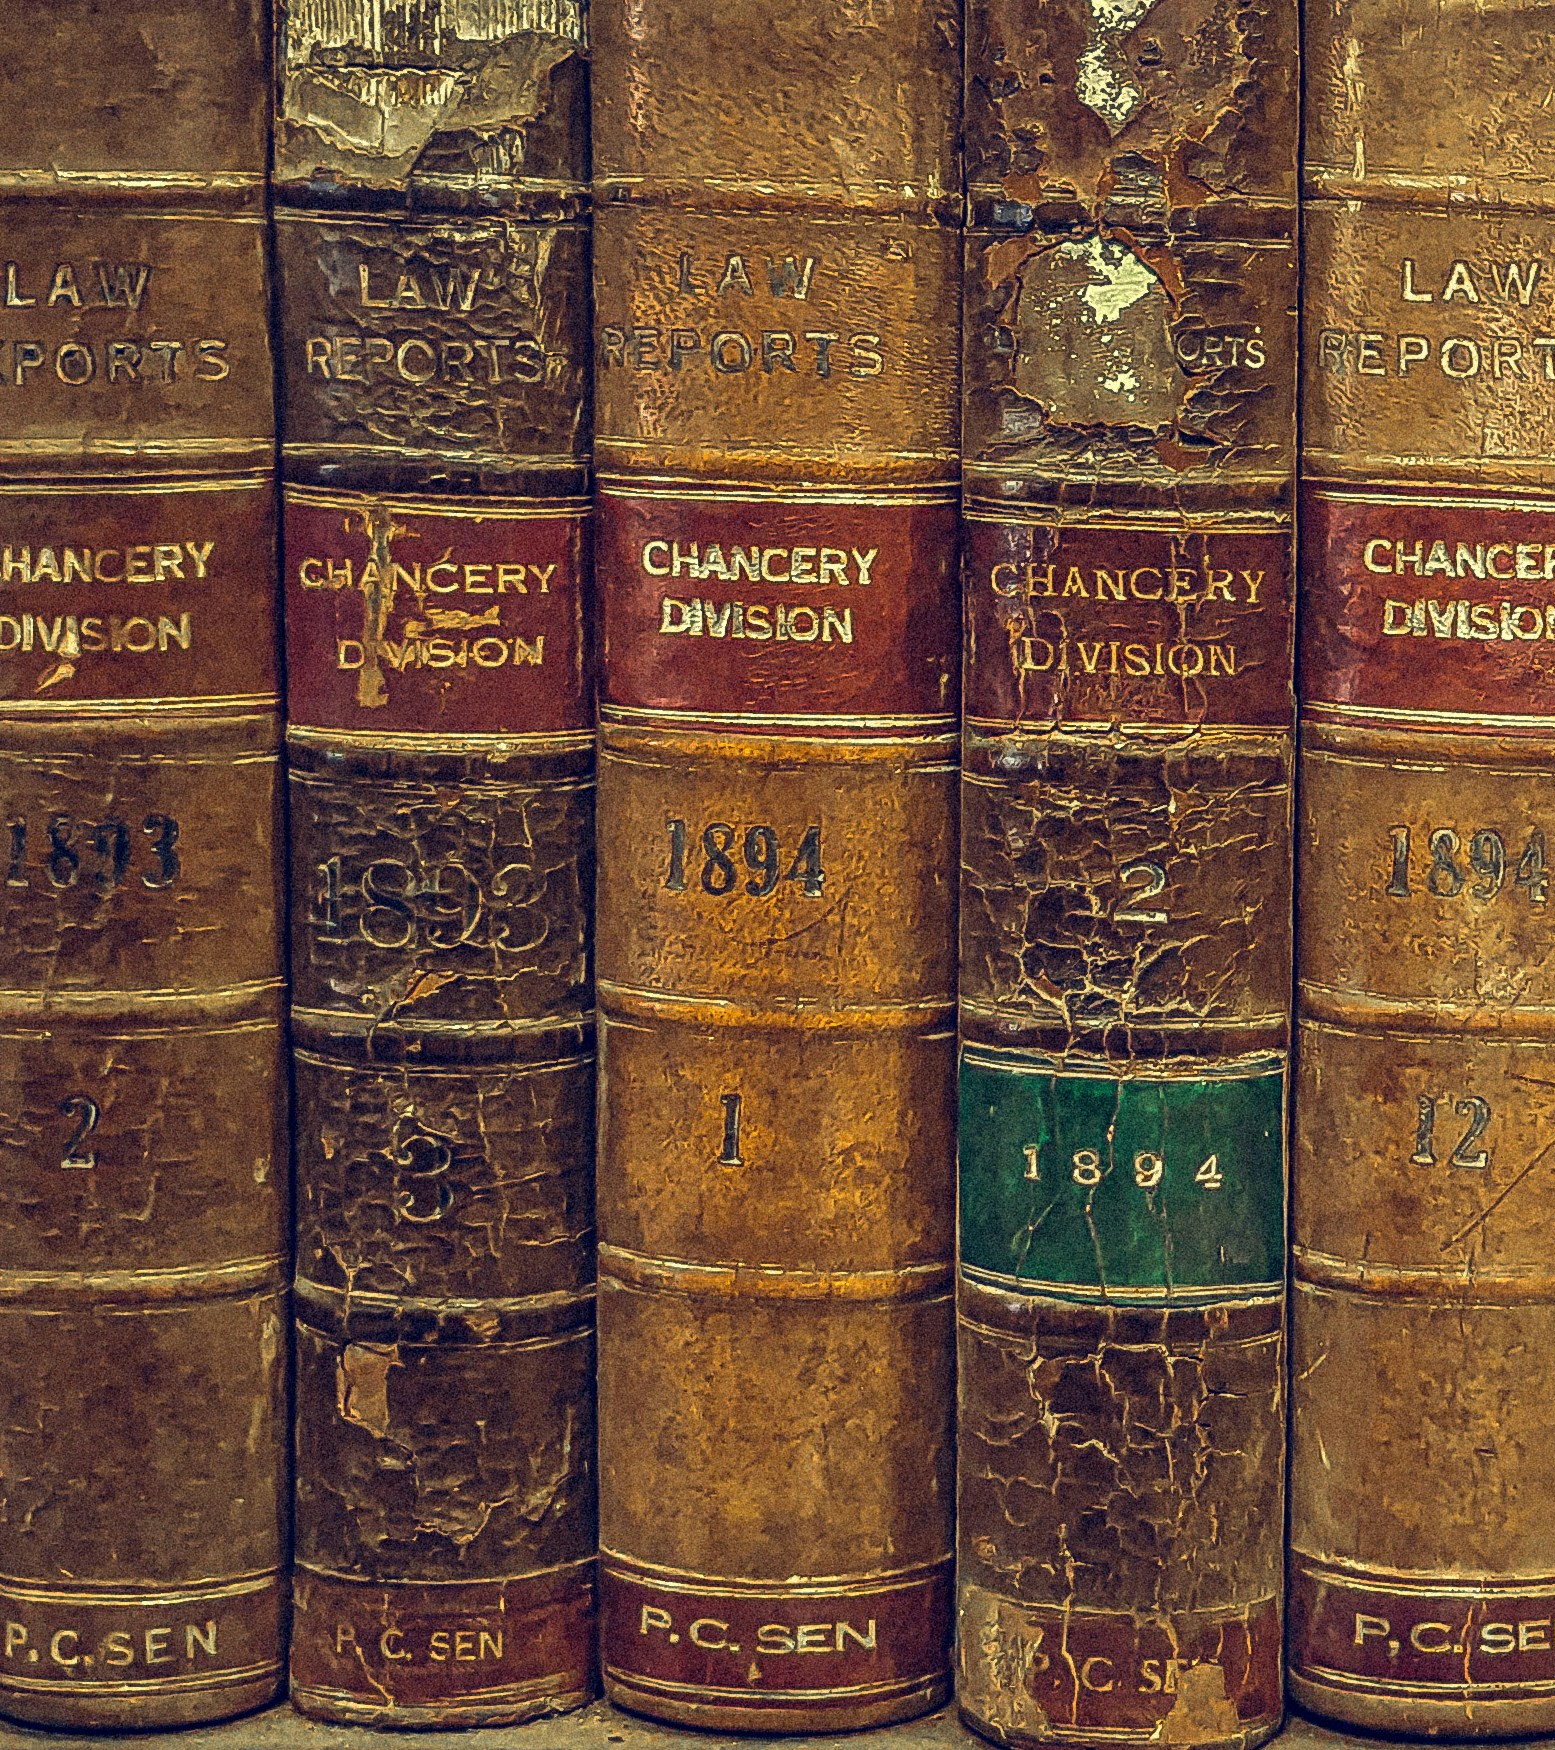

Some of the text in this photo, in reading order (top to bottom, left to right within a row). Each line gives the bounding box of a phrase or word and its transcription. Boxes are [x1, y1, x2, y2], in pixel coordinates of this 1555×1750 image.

[6, 261, 151, 307] LAW
[359, 264, 482, 310] LAW
[679, 251, 815, 300] LAW
[1402, 258, 1540, 305] LAW
[0, 338, 230, 386] PORTS
[306, 336, 544, 385] REPORTS
[602, 325, 887, 379] REPORTS
[0, 541, 214, 583] HANCERY
[299, 556, 557, 594] CHANCERY
[642, 540, 878, 586] CHANCERY
[990, 561, 1266, 604] CHANCERY
[658, 596, 854, 643] DIVISION
[336, 635, 545, 671] DVISION
[1020, 636, 1237, 677] DIVISION
[6, 814, 182, 890] 1893
[663, 819, 826, 898] 1894
[1385, 823, 1550, 903] 1894
[1113, 860, 1169, 924] 2
[61, 1096, 100, 1170] 2
[718, 1093, 745, 1168] 1
[1410, 1095, 1493, 1170] 12
[1022, 1144, 1223, 1188] 1894
[429, 1630, 503, 1661] SEN
[756, 1619, 877, 1654] SEN
